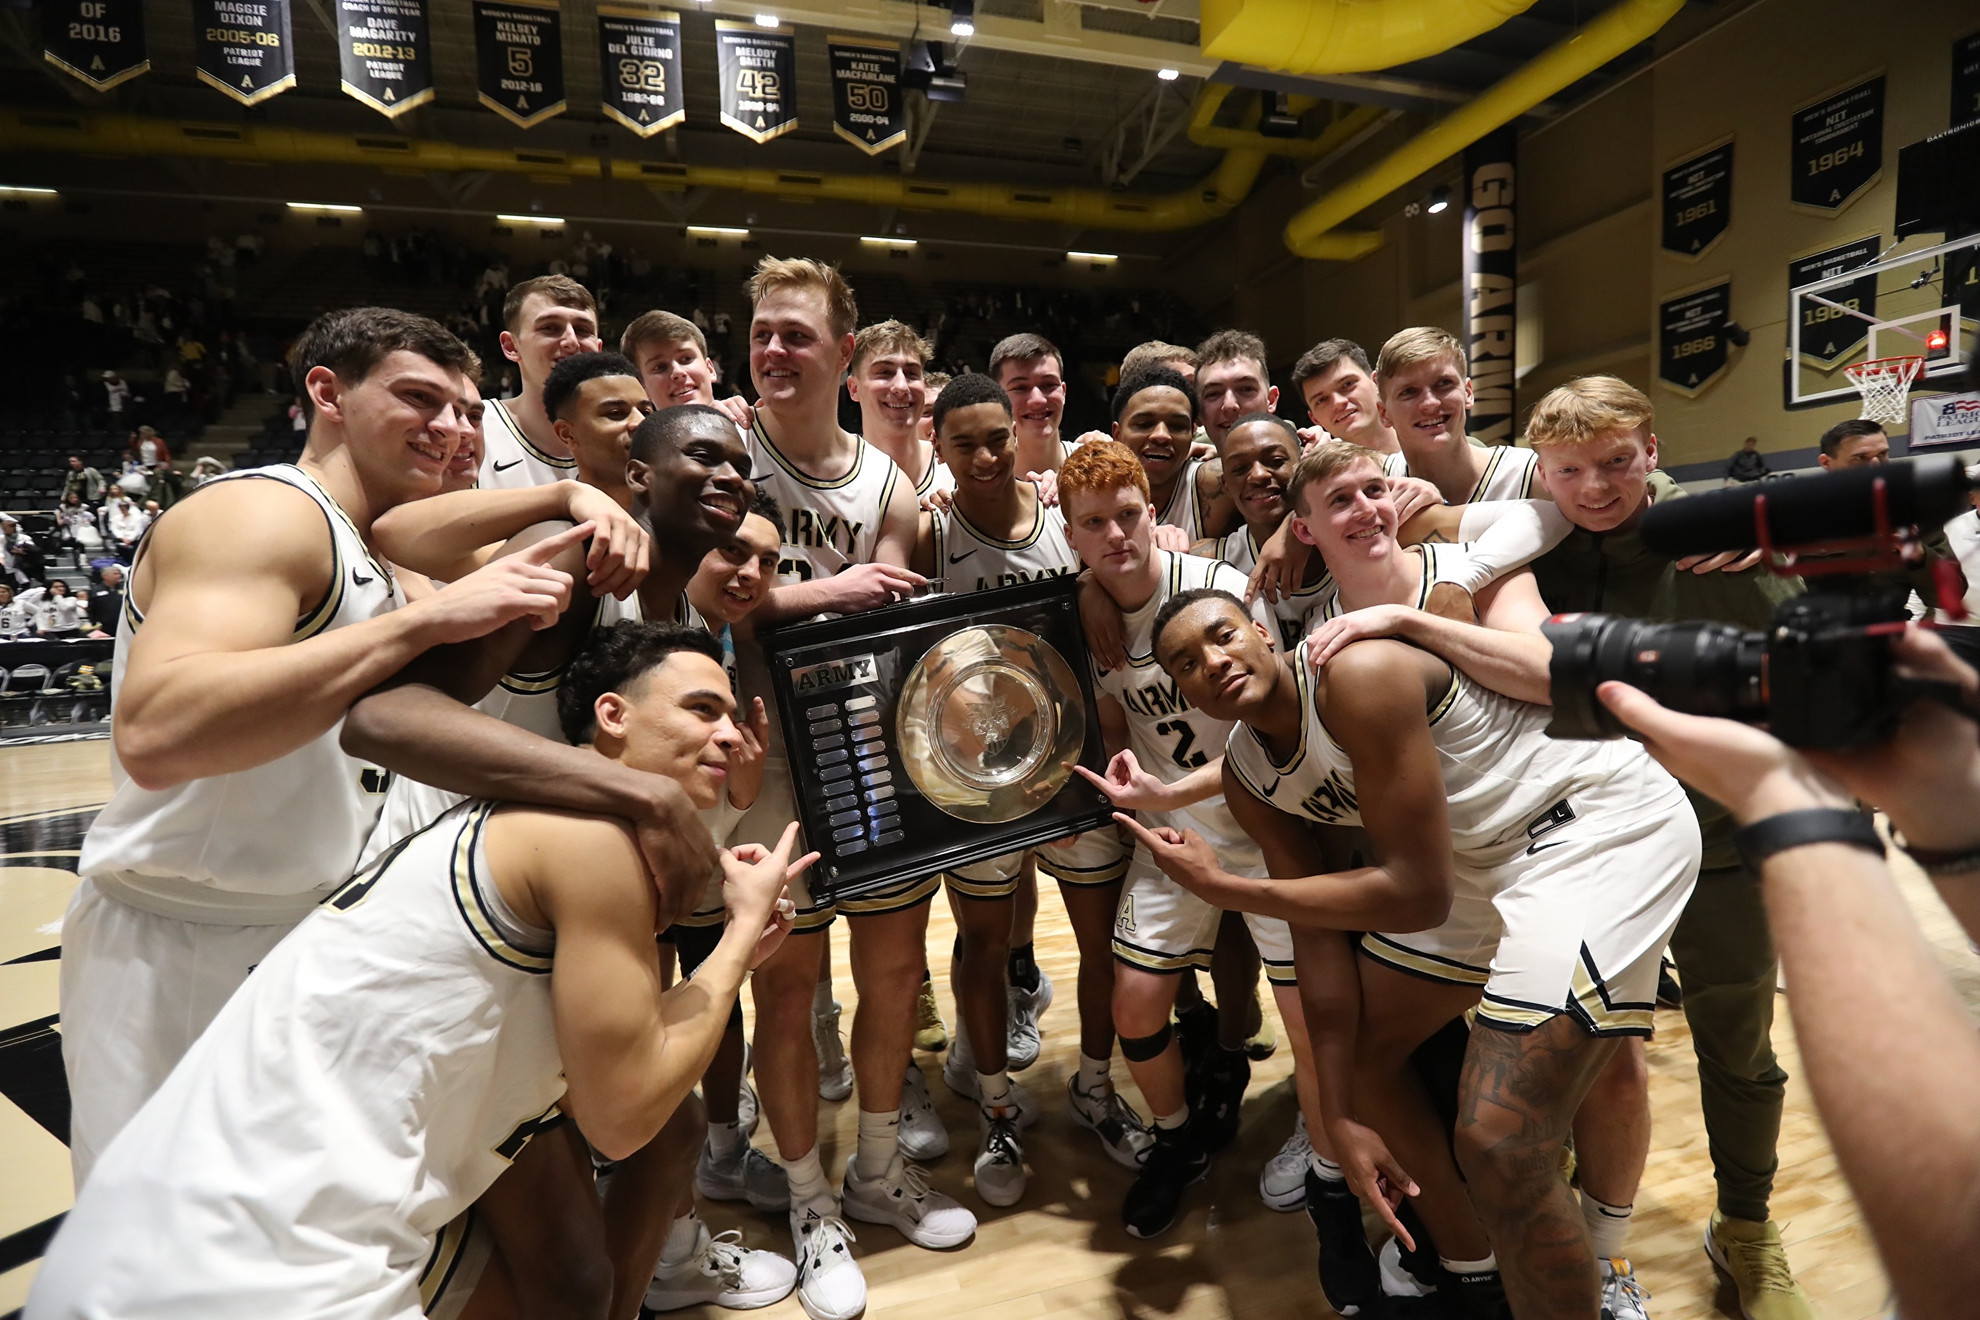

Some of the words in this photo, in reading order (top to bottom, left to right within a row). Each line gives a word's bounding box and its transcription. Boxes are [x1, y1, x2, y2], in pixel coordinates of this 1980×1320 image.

[80, 2, 107, 18] OF
[214, 1, 268, 17] MAGGIE
[220, 13, 263, 26] DIXON
[367, 17, 399, 29] DAVE
[69, 22, 121, 43] 2016
[349, 26, 416, 42] MAGARITY
[496, 21, 538, 35] KELSEY
[206, 28, 280, 47] 2005-06
[495, 31, 541, 46] MINATO
[625, 35, 655, 47] JULIE
[223, 47, 264, 58] PATRIOT
[353, 42, 416, 60] 2012-13
[608, 43, 628, 54] DEL
[630, 46, 673, 59] GIORNO
[736, 46, 777, 59] MELODY
[227, 56, 262, 67] LEAGUE
[508, 47, 533, 76] 5
[739, 56, 775, 68] SMITH
[851, 61, 880, 72] KATIE
[241, 74, 255, 88] A
[619, 59, 665, 92] 32
[836, 69, 896, 84] MACFARLANE
[736, 69, 780, 99] 42
[847, 83, 888, 112] 50
[1825, 109, 1848, 127] NIT
[1808, 140, 1864, 176] 1964
[1471, 162, 1515, 253] GO
[1676, 199, 1718, 227] 1961
[1823, 341, 1837, 355] A
[780, 508, 864, 554] RMY
[798, 658, 871, 691] ARMY
[1122, 679, 1189, 716] ARM
[1156, 719, 1209, 769] 2
[1116, 893, 1137, 931] A
